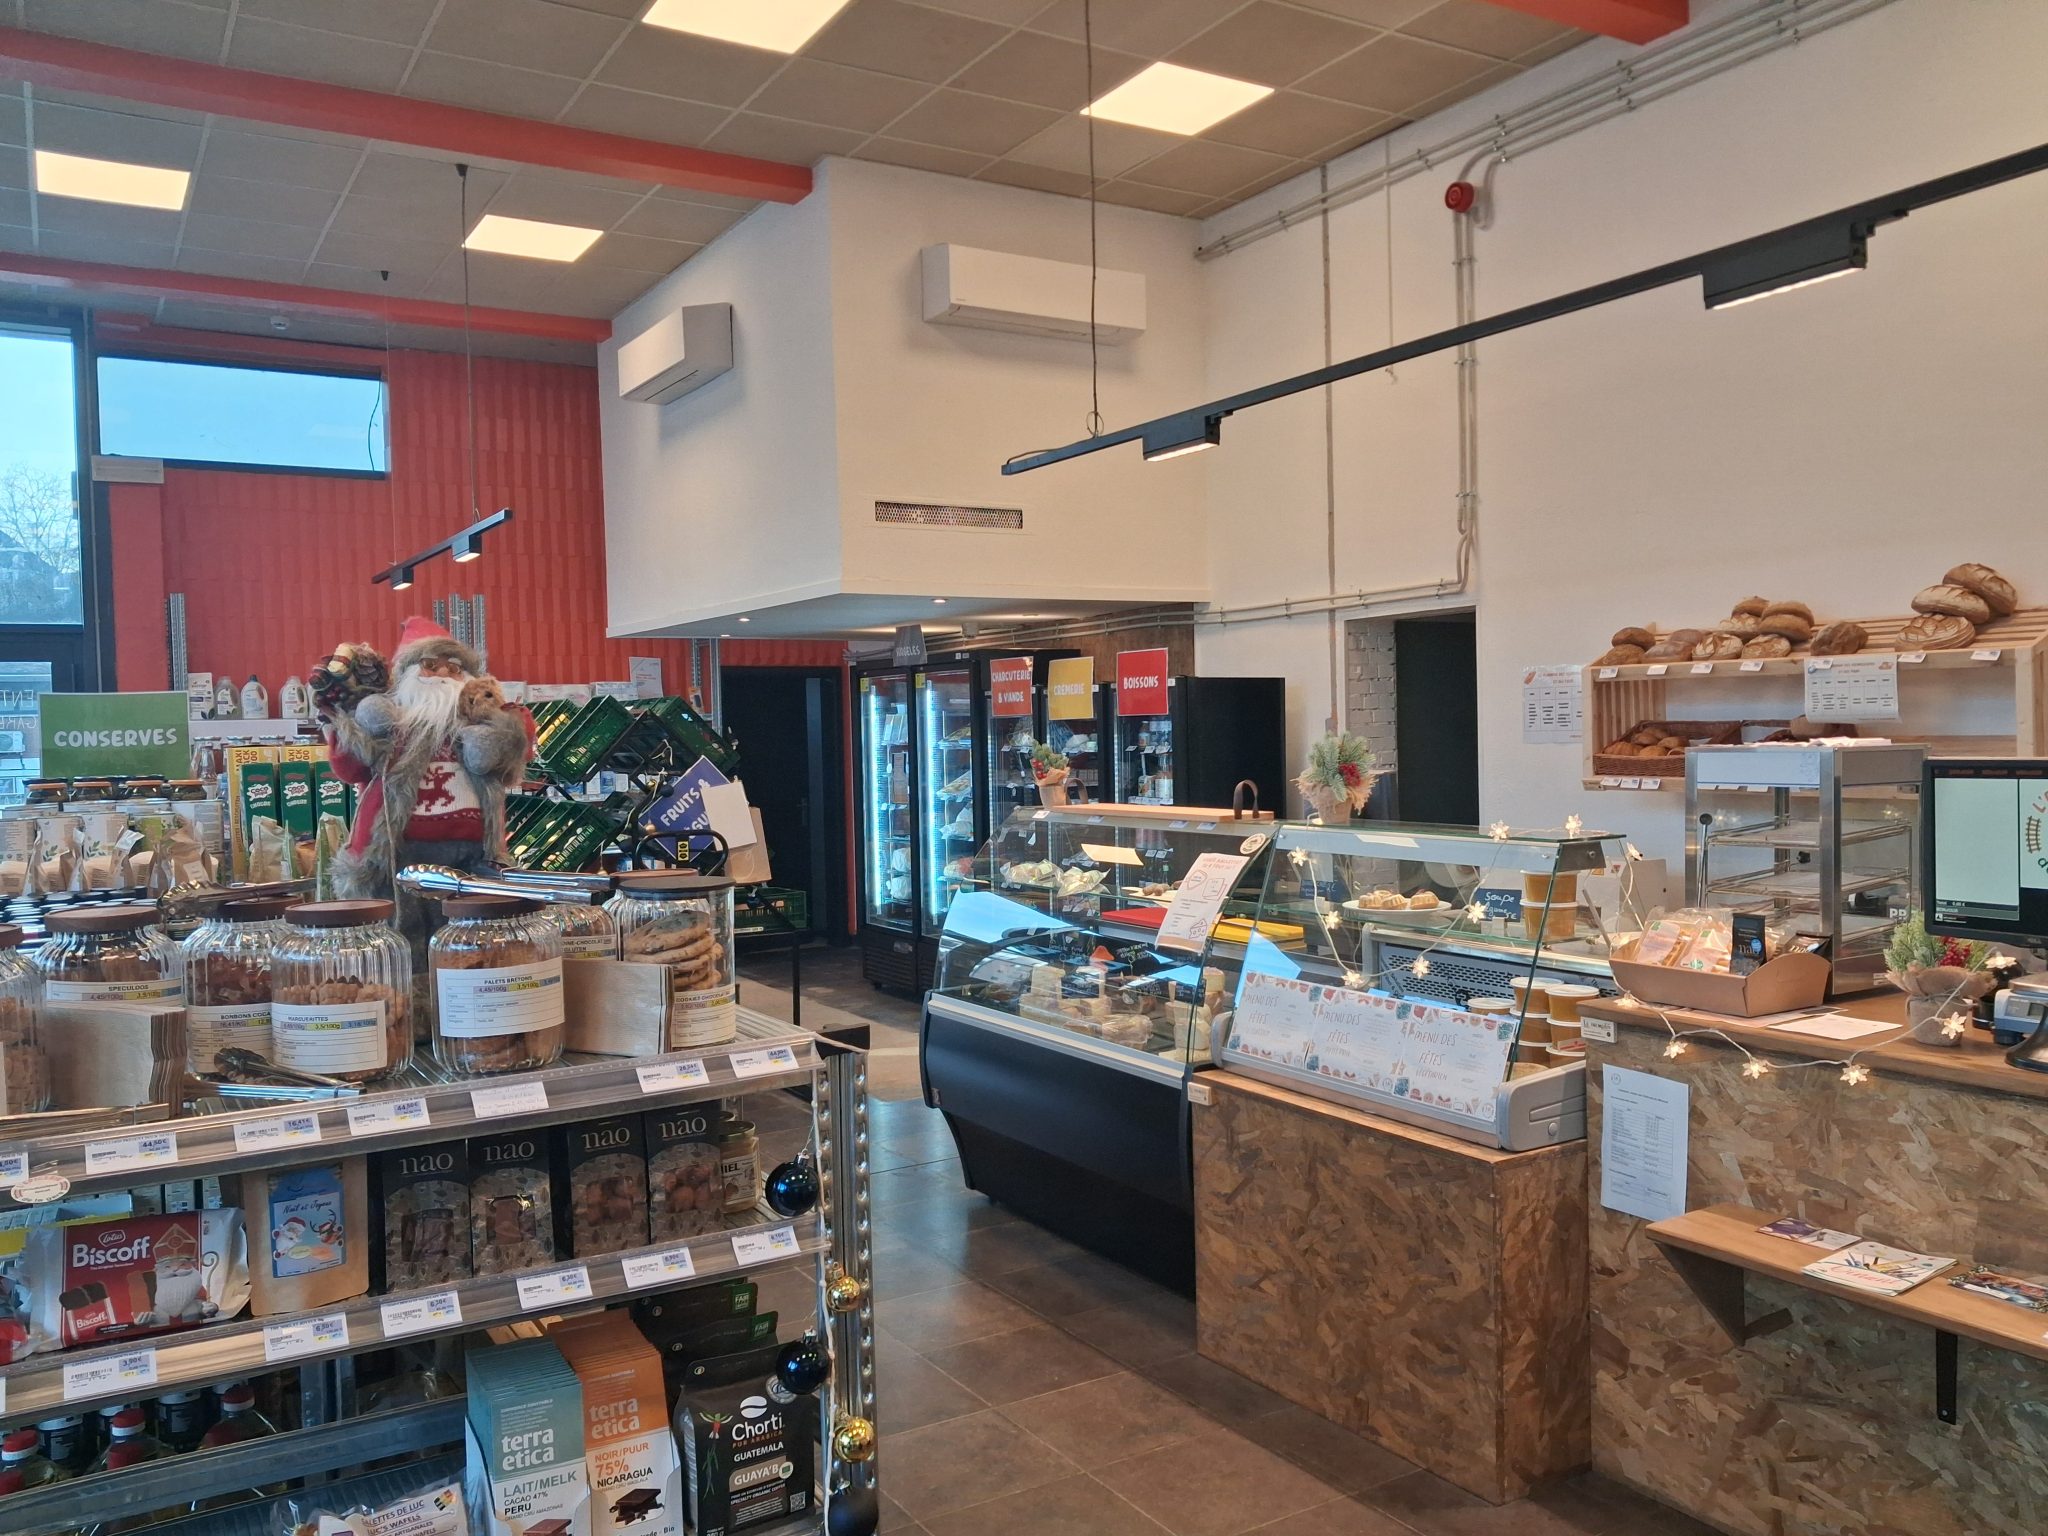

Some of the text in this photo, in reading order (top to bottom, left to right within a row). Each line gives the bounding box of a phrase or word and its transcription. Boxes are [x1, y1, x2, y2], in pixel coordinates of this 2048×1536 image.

[1123, 675, 1159, 690] BOISSONS
[1003, 691, 1024, 703] VIANDE
[54, 728, 178, 748] CONSERVES
[660, 787, 700, 827] FRUITS
[108, 984, 149, 992] SPECULOOS
[1323, 1011, 1362, 1026] MENU DES
[1414, 1030, 1457, 1047] MENU DES
[1419, 1050, 1446, 1066] FÊTES
[658, 1116, 707, 1139] nao
[142, 1139, 168, 1148] 44,50€
[581, 1127, 630, 1149] nao
[484, 1141, 535, 1162] nao
[400, 1153, 454, 1174] nao
[102, 1231, 124, 1244] Lotus
[72, 1235, 150, 1268] Biscoff
[76, 1311, 108, 1328] Biscoff
[589, 1398, 639, 1422] terra
[591, 1415, 640, 1440] etica
[732, 1412, 783, 1441] Chorti
[501, 1428, 554, 1453] terra
[502, 1446, 555, 1471] etica
[595, 1442, 649, 1463] NOIR/PUUR
[733, 1441, 784, 1462] GUATEMALA
[595, 1459, 629, 1478] 75%
[597, 1467, 653, 1488] NICARAGUA
[503, 1470, 577, 1498] LAIT/MELK
[396, 1507, 407, 1516] DE
[409, 1500, 425, 1511] LUC
[504, 1491, 549, 1507] CACAO 47%
[504, 1503, 532, 1516] PERU
[389, 1514, 422, 1529] WAFELS
[663, 1525, 675, 1534] Bio
